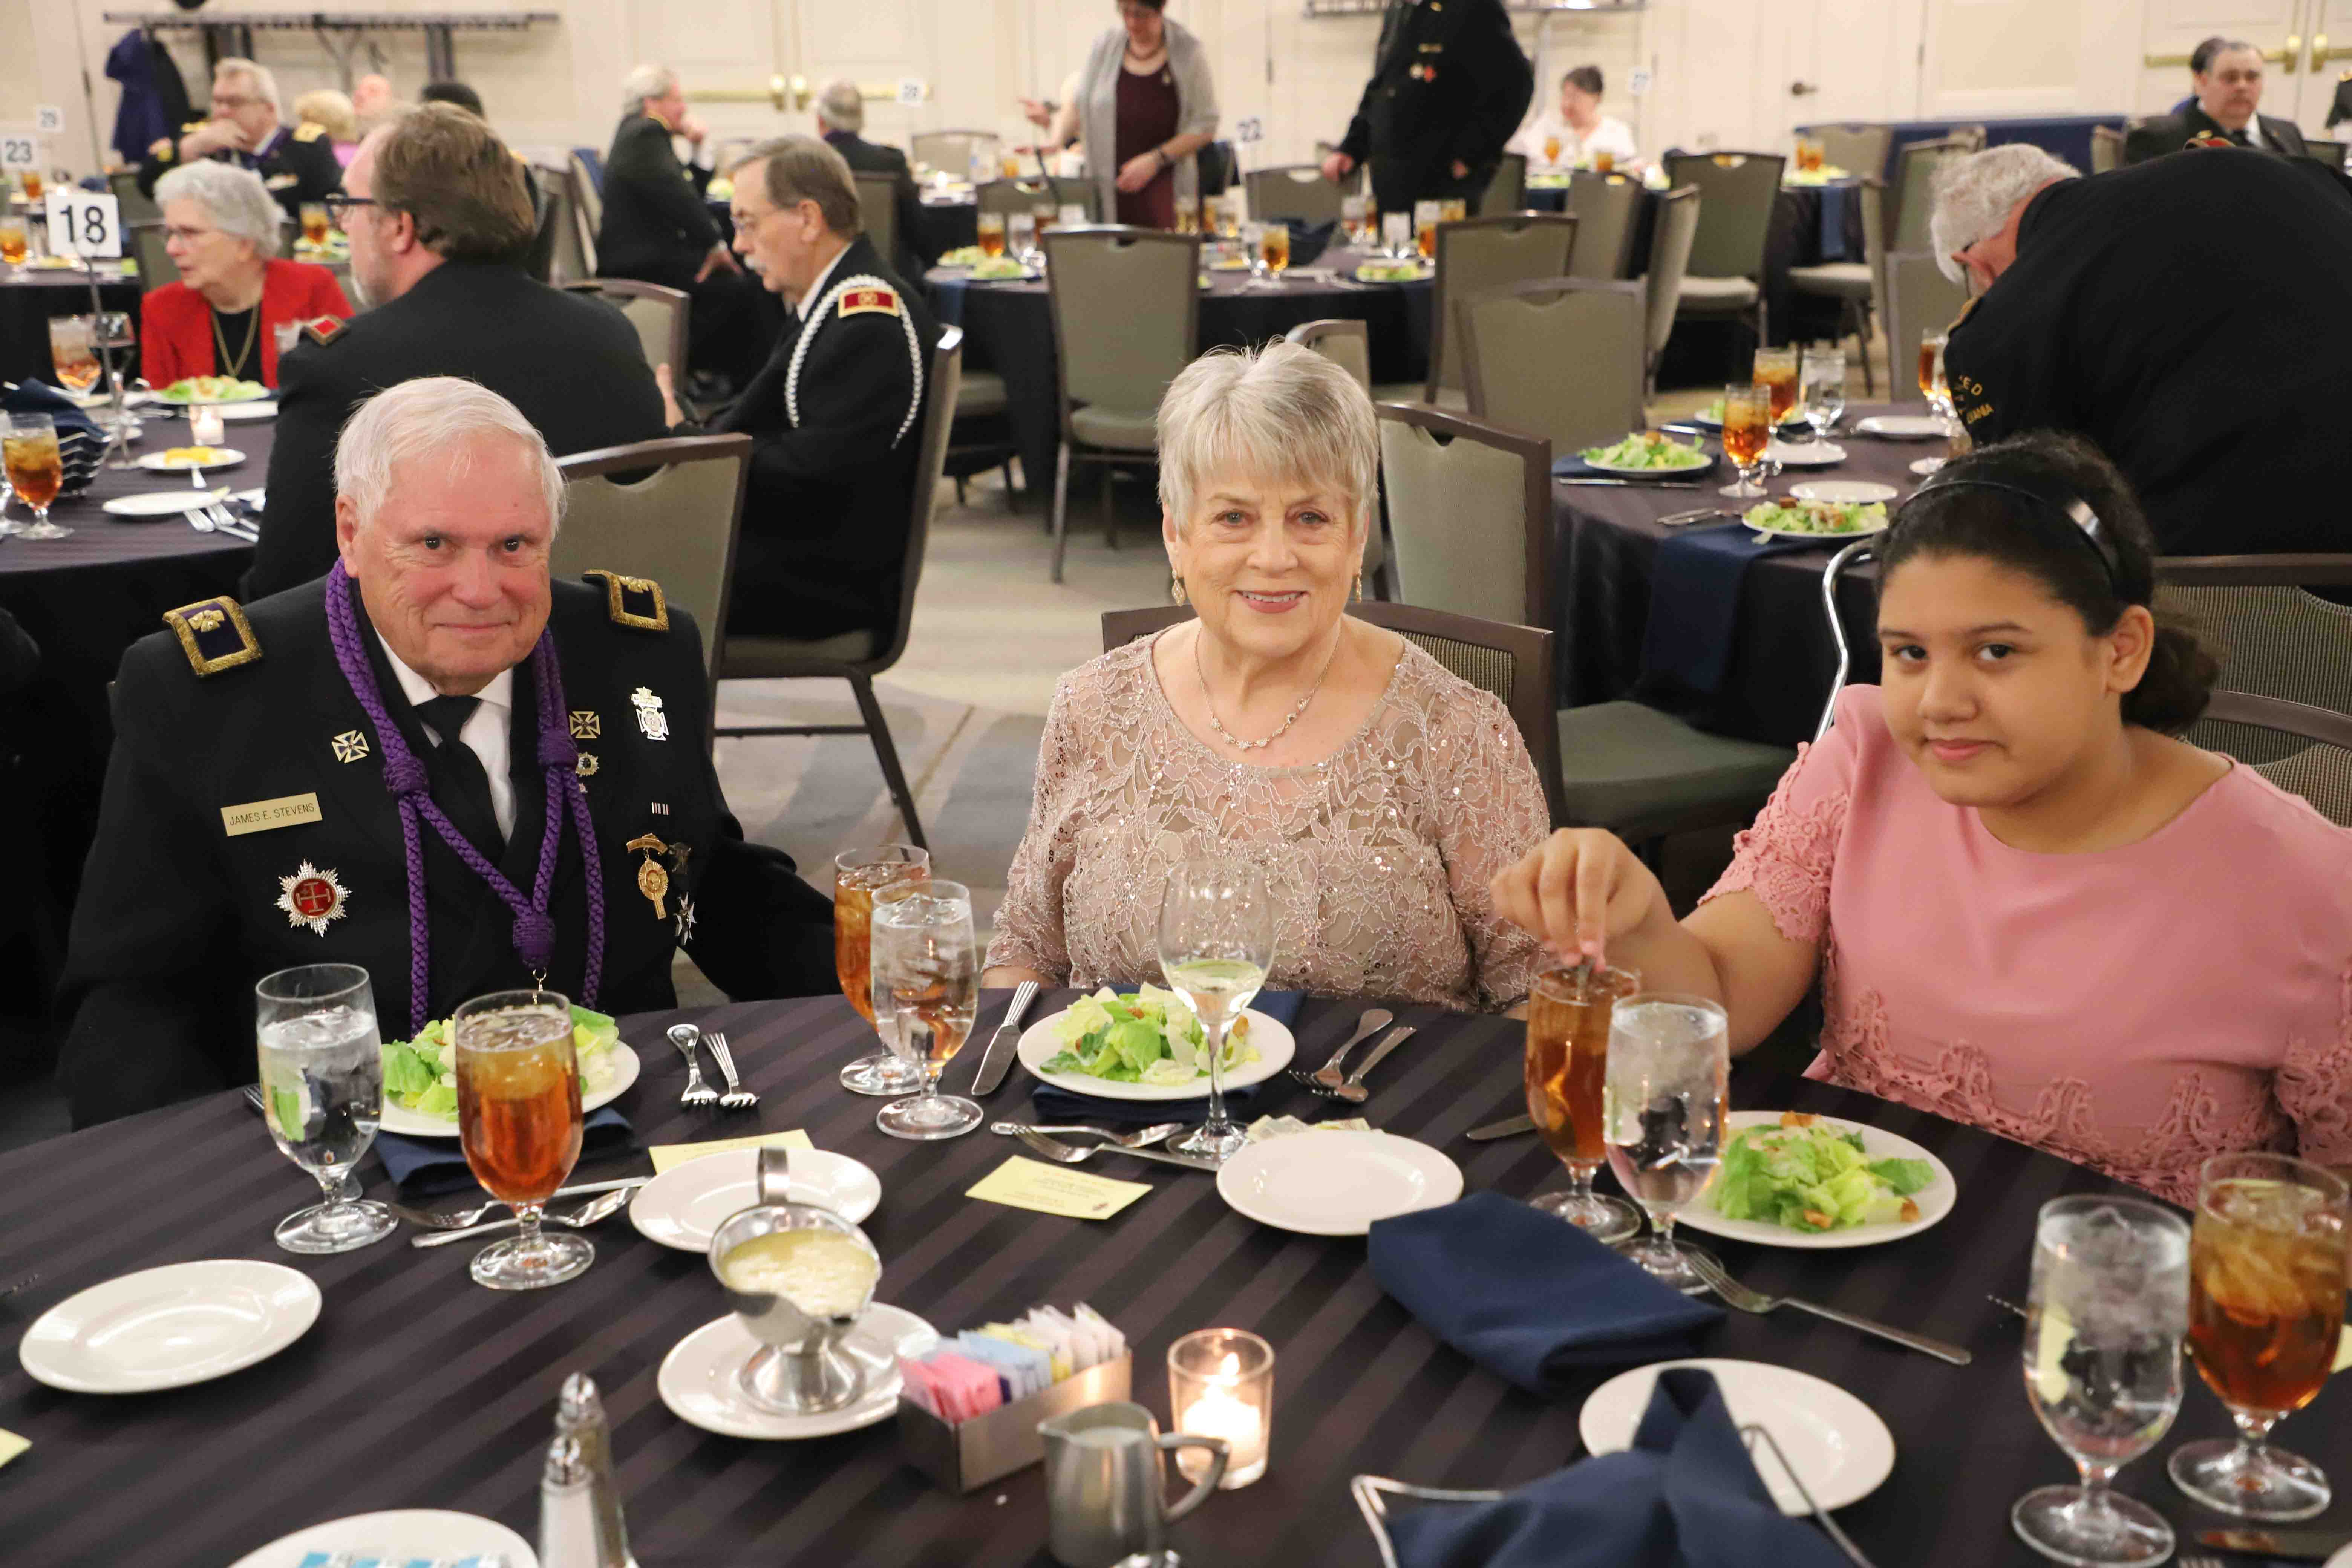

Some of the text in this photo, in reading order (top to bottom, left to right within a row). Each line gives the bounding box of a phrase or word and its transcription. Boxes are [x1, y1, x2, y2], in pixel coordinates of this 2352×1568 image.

[1237, 118, 1263, 142] 22
[6, 140, 32, 163] 23
[59, 205, 107, 244] 18
[229, 802, 315, 826] JAMES E. STEVENS
